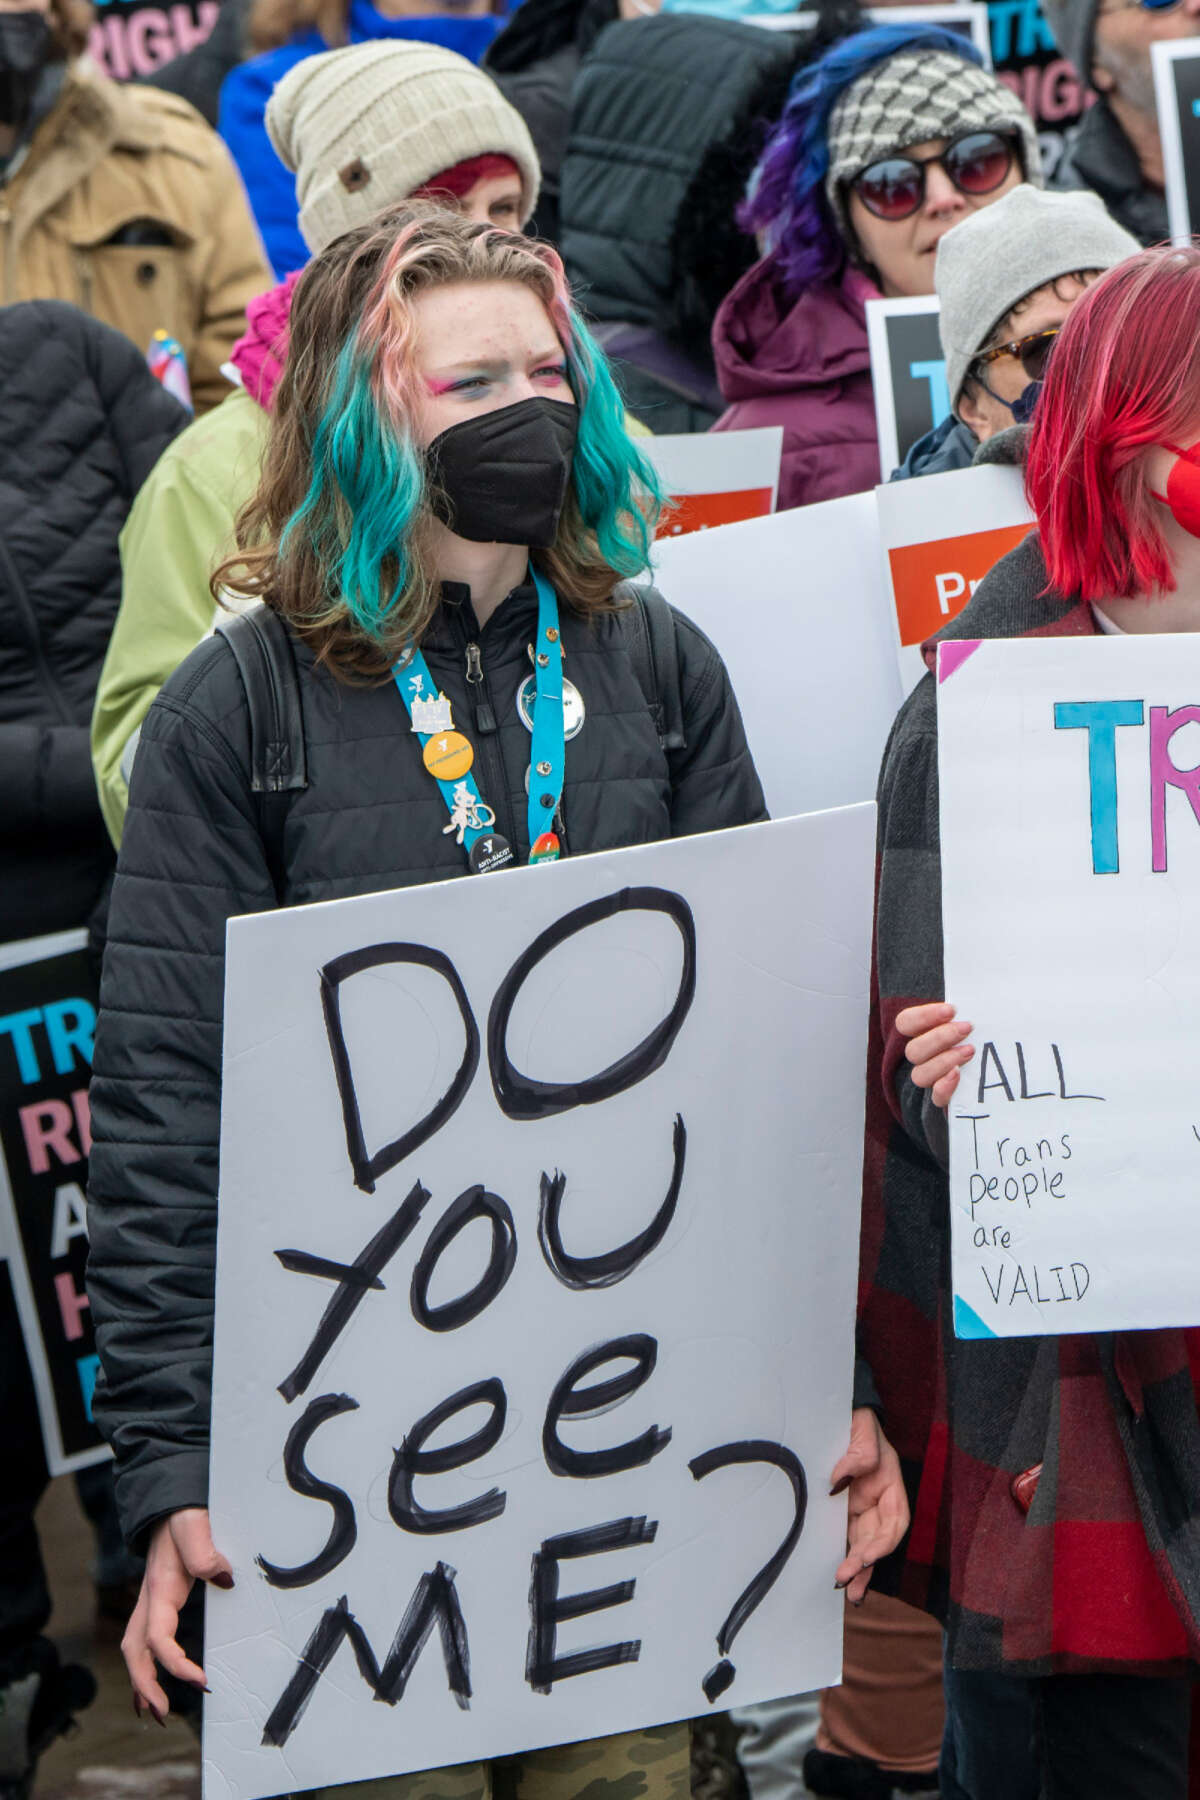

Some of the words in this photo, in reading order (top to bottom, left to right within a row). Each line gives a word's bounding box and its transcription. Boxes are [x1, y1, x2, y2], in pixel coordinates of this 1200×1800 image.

[317, 886, 697, 1194] DO
[977, 1042, 1106, 1103] ALL
[955, 1114, 1072, 1170] Trans
[969, 1167, 1066, 1222] people
[973, 1225, 1011, 1249] are
[981, 1262, 1090, 1306] VALID
